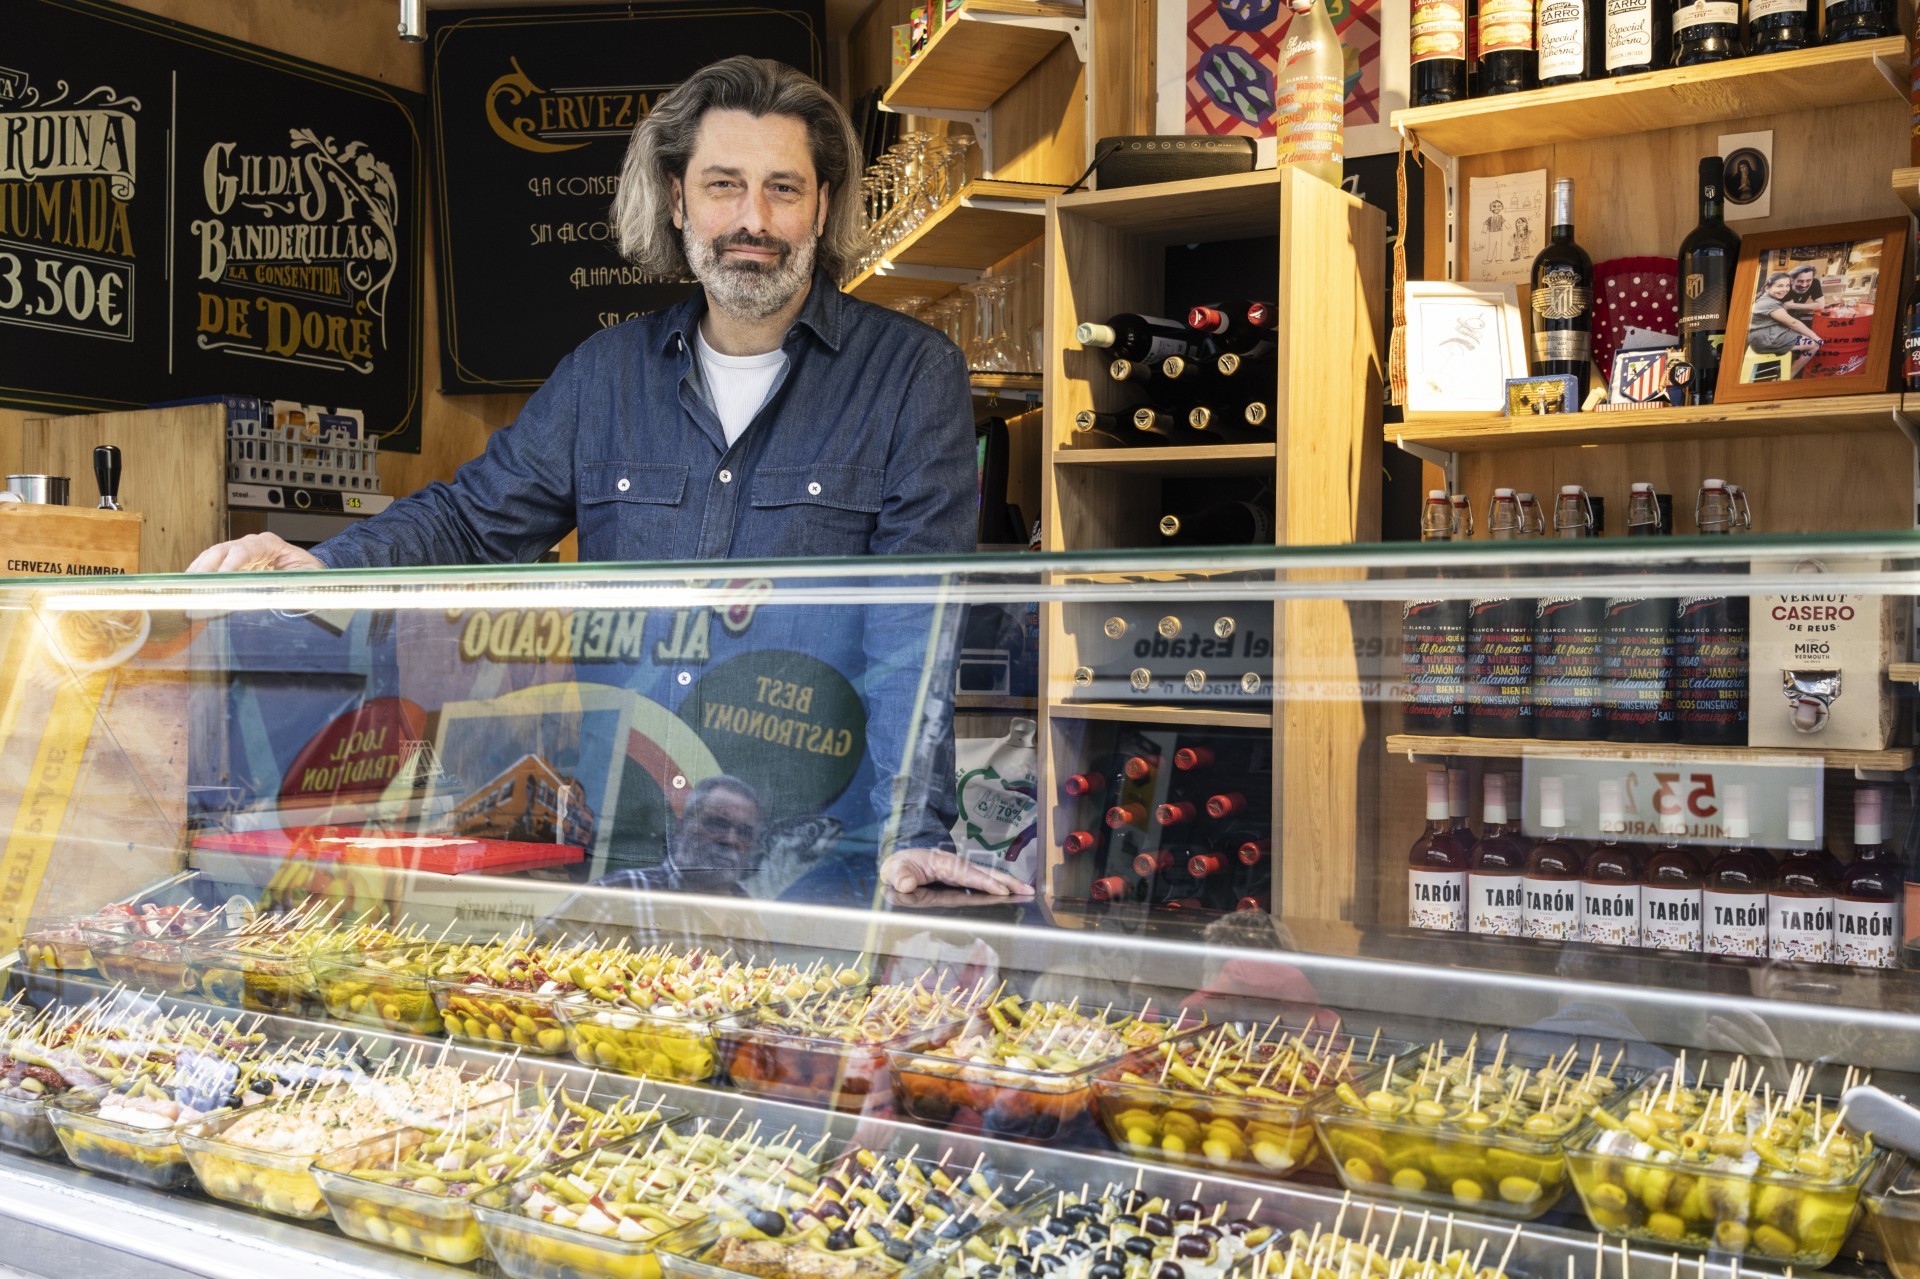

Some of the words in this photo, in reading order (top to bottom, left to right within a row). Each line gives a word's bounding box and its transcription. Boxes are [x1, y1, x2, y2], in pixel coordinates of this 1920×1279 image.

[1608, 0, 1646, 12] ZARRO
[1541, 9, 1579, 22] ZARRO
[1296, 82, 1323, 91] PADRÓN
[528, 177, 551, 197] LA
[530, 223, 551, 246] SIN
[191, 219, 374, 284] BANDERILLAS
[229, 267, 248, 281] LA
[255, 264, 342, 296] CONSENTIDA
[0, 252, 123, 327] 3,50€
[197, 292, 252, 340] DE
[7, 559, 62, 575] CERVEZAS
[1780, 593, 1848, 603] VERMUT
[1771, 605, 1855, 621] CASERO
[1789, 623, 1803, 632] DE
[1807, 623, 1836, 632] REUS
[1417, 634, 1445, 643] PADRÓN
[1483, 634, 1511, 643] PADRÓN
[1554, 635, 1583, 643] PADRÓN
[1619, 636, 1649, 645] PADRÓN
[1697, 635, 1728, 644] PADRÓN
[1429, 643, 1457, 655] fresco
[1494, 643, 1522, 656] fresco
[1566, 645, 1595, 657] fresco
[1631, 646, 1662, 658] fresco
[1710, 644, 1739, 657] fresco
[1794, 641, 1830, 654] MIRÓ
[1422, 656, 1443, 664] MUY
[1488, 656, 1509, 665] MUY
[1559, 656, 1582, 665] MUY
[1623, 658, 1645, 667] MUY
[1702, 657, 1726, 667] MUY
[1425, 664, 1454, 675] JAMÓN
[1491, 665, 1520, 676] JAMÓN
[1563, 666, 1592, 677] JAMÓN
[1628, 668, 1659, 679] JAMÓN
[1707, 668, 1738, 679] JAMÓN
[1410, 673, 1461, 684] Calamares
[1476, 674, 1527, 685] Calamares
[1546, 676, 1599, 687] Calamares
[1612, 678, 1667, 689] Calamares
[1689, 678, 1745, 689] Calamares
[1435, 685, 1455, 694] BIEN
[1501, 686, 1521, 695] BIEN
[1574, 687, 1594, 697] BIEN
[1638, 690, 1659, 700] BIEN
[1416, 694, 1454, 704] CONSERVAS
[1481, 696, 1520, 705] CONSERVAS
[1719, 691, 1740, 700] BIEN
[1552, 697, 1593, 707] CONSERVAS
[1618, 700, 1659, 710] CONSERVAS
[1697, 700, 1739, 711] CONSERVAS
[997, 804, 1022, 822] 70%
[1415, 880, 1460, 902] TARÓN
[1485, 884, 1522, 907] TARÓ
[1527, 889, 1574, 911] TARÓN
[1585, 894, 1634, 917] TARÓN
[1649, 898, 1699, 921] TARÓN
[1715, 903, 1766, 926] TARÓN
[1781, 907, 1833, 931] TARÓN
[1839, 912, 1892, 936] TARÓN
